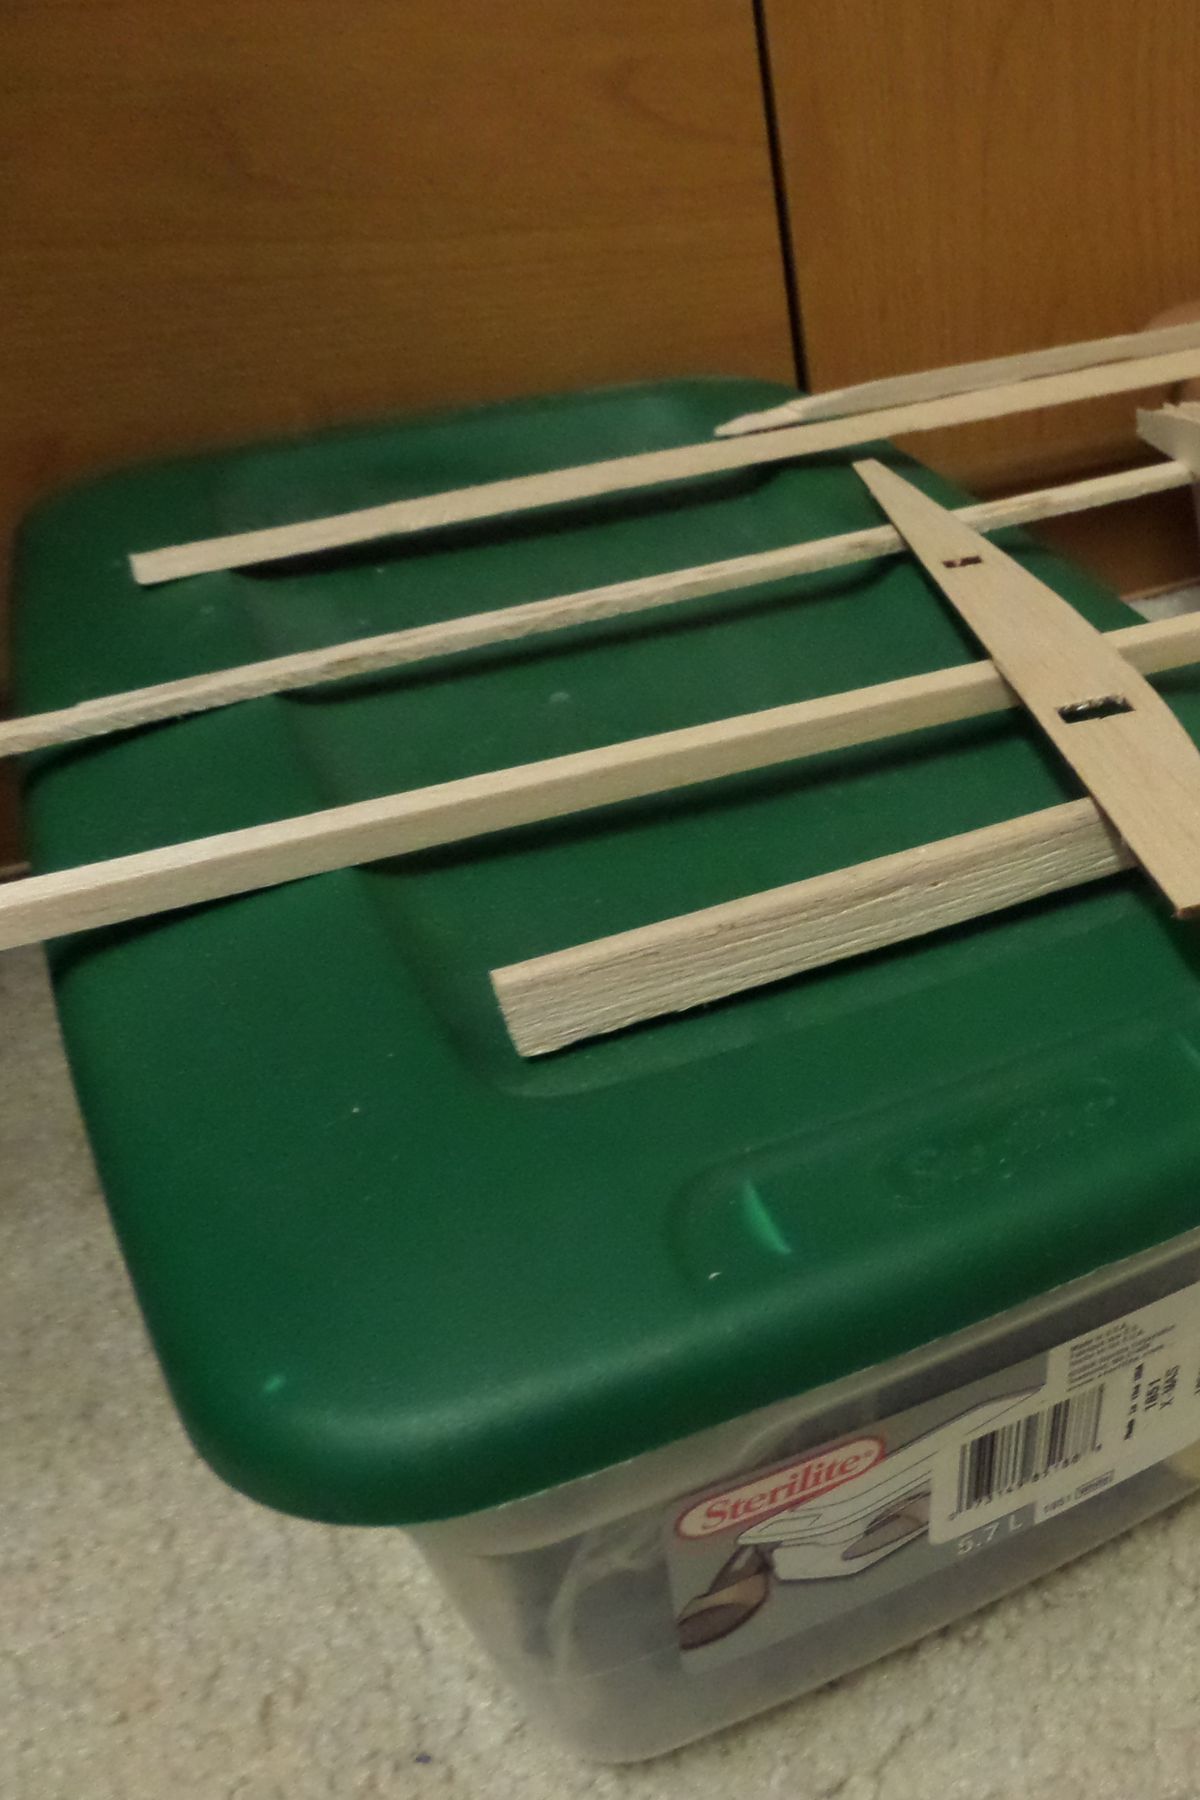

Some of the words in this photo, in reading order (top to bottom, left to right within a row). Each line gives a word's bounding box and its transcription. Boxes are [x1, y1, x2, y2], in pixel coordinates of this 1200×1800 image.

[1144, 1378, 1161, 1412] 1851
[702, 1454, 861, 1531] Sterilite
[957, 1521, 1000, 1555] 5.7
[1008, 1513, 1024, 1532] L
